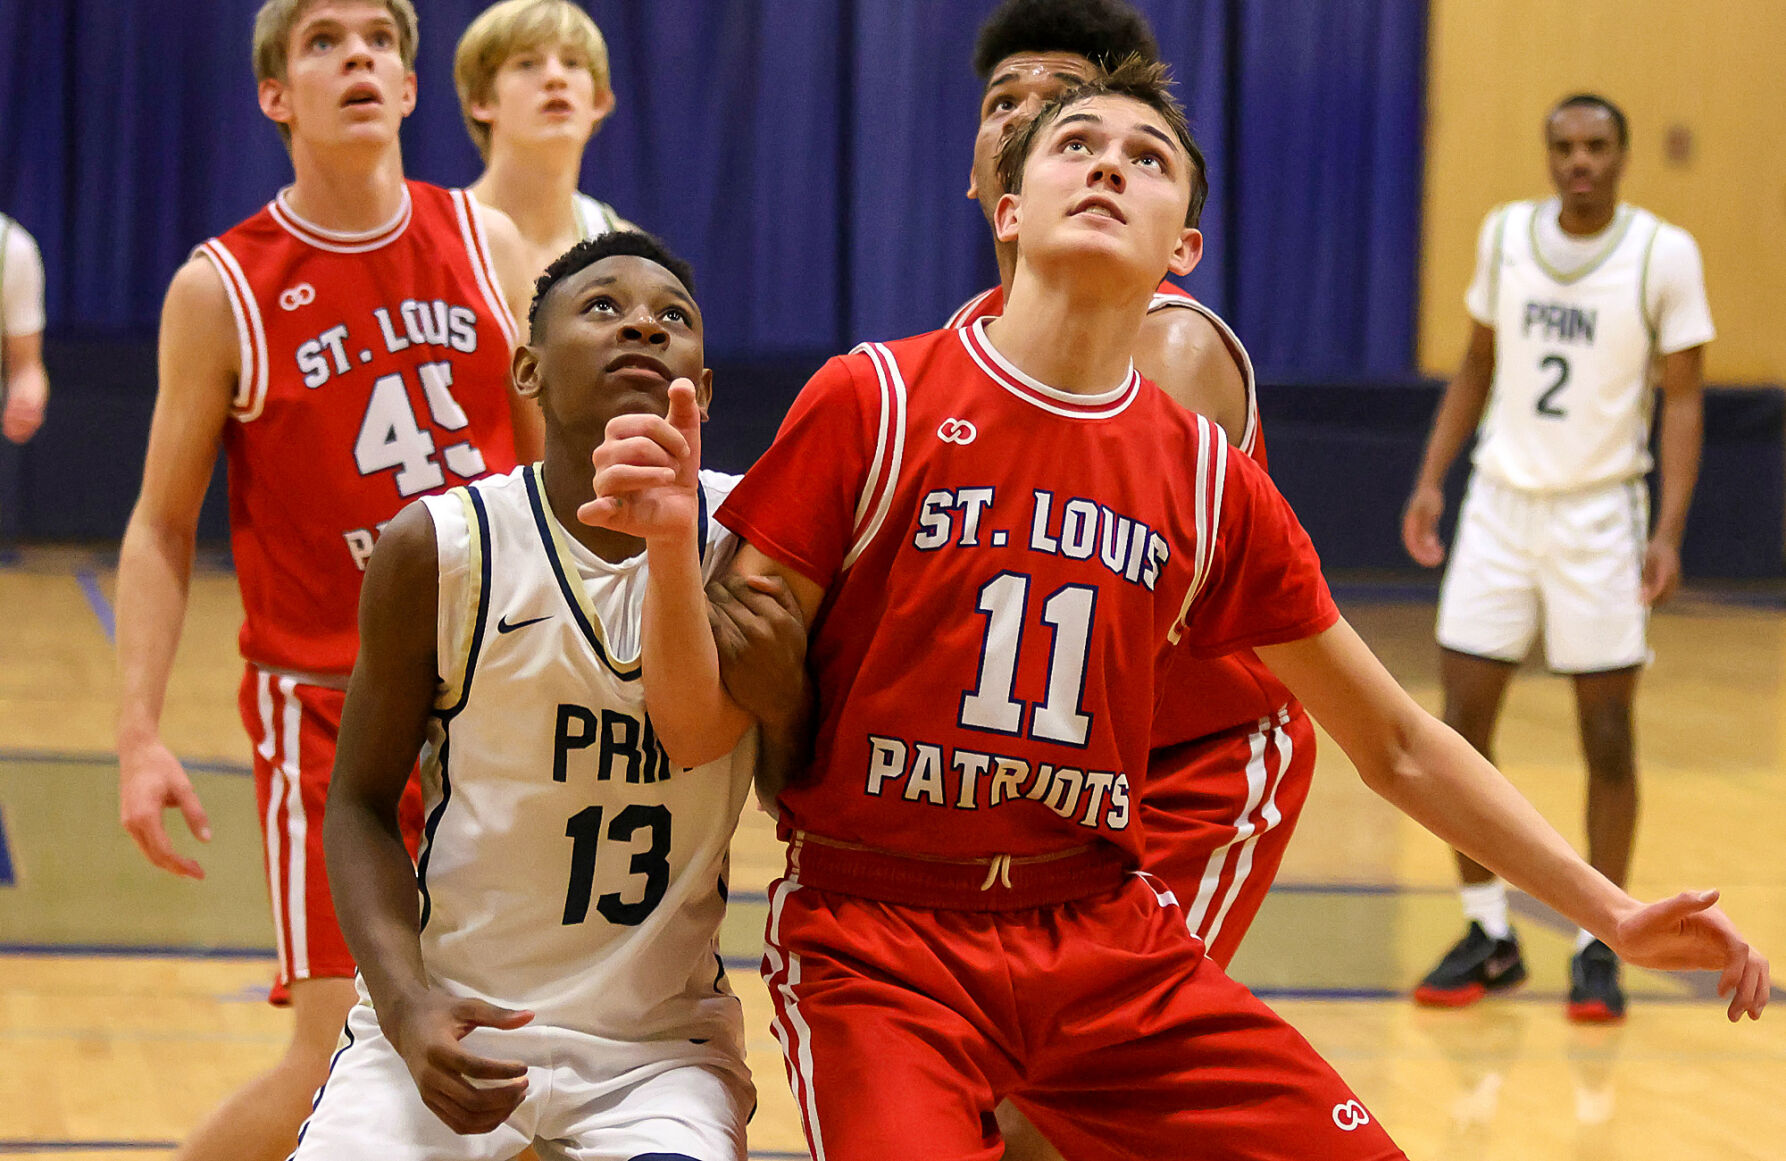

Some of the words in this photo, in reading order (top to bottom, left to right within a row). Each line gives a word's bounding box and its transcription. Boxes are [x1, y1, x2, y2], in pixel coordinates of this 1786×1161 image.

[295, 323, 373, 390] ST.
[373, 298, 477, 354] LOUS
[1536, 355, 1568, 416] 2
[353, 360, 487, 498] 45
[914, 485, 1009, 552] ST.
[1028, 488, 1170, 592] LOUIS
[957, 568, 1099, 750] 11
[864, 733, 1131, 832] PATRIOTS
[562, 803, 672, 926] 13
